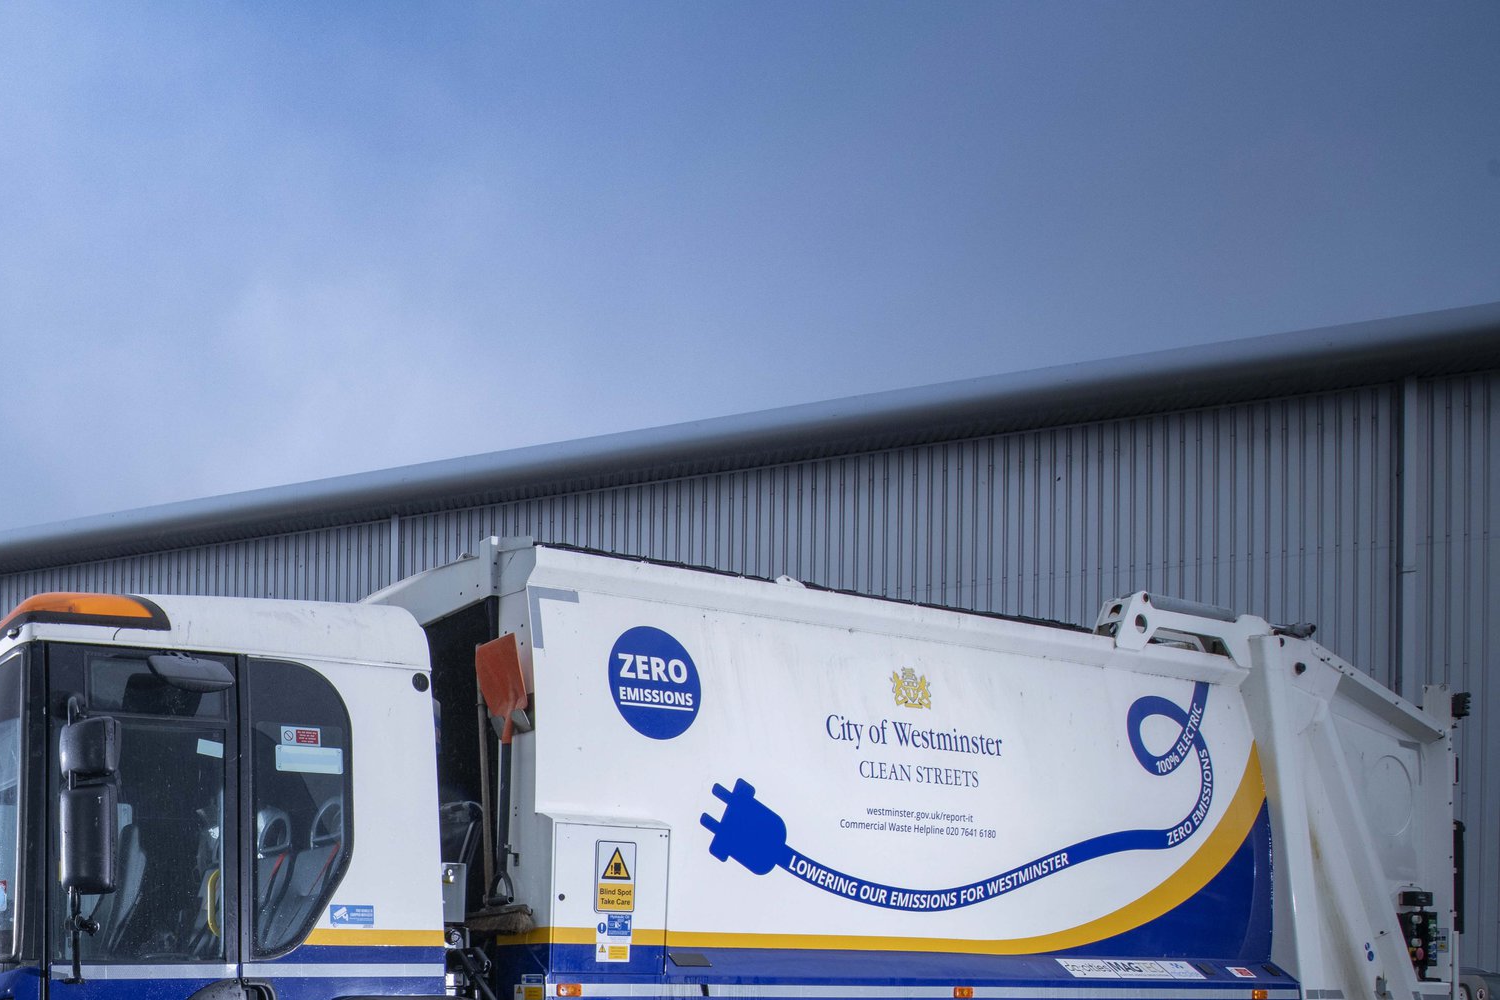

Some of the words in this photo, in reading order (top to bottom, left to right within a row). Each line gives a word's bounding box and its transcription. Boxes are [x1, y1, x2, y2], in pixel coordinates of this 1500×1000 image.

[617, 652, 688, 684] ZERO
[618, 686, 693, 706] EMISSIONS
[826, 713, 864, 750] City
[868, 719, 888, 745] of
[892, 720, 1003, 757] Westminster
[1155, 752, 1180, 774] 100%
[1176, 702, 1202, 757] ELECTRIC
[859, 760, 911, 783] CLEAN
[916, 765, 980, 788] STREETS
[1166, 821, 1193, 846] ZERO
[1191, 748, 1212, 827] EMISSIONS
[866, 806, 974, 823] westminster.gov.uk/report-it
[839, 818, 887, 832] Commercial
[888, 822, 912, 834] Waste
[913, 824, 945, 837] Helpline
[945, 826, 959, 837] 020
[960, 827, 978, 838] 7641
[979, 828, 997, 839] 6180
[788, 854, 858, 897] LOWERING
[860, 884, 888, 905] OUR
[889, 890, 957, 909] EMISSIONS
[960, 885, 985, 905] FOR
[986, 852, 1070, 896] WESTMINSTER
[599, 887, 616, 896] Blind
[617, 888, 632, 900] Spot
[600, 897, 615, 906] Take
[615, 898, 631, 906] Care
[1106, 961, 1164, 973] MAGTEC
